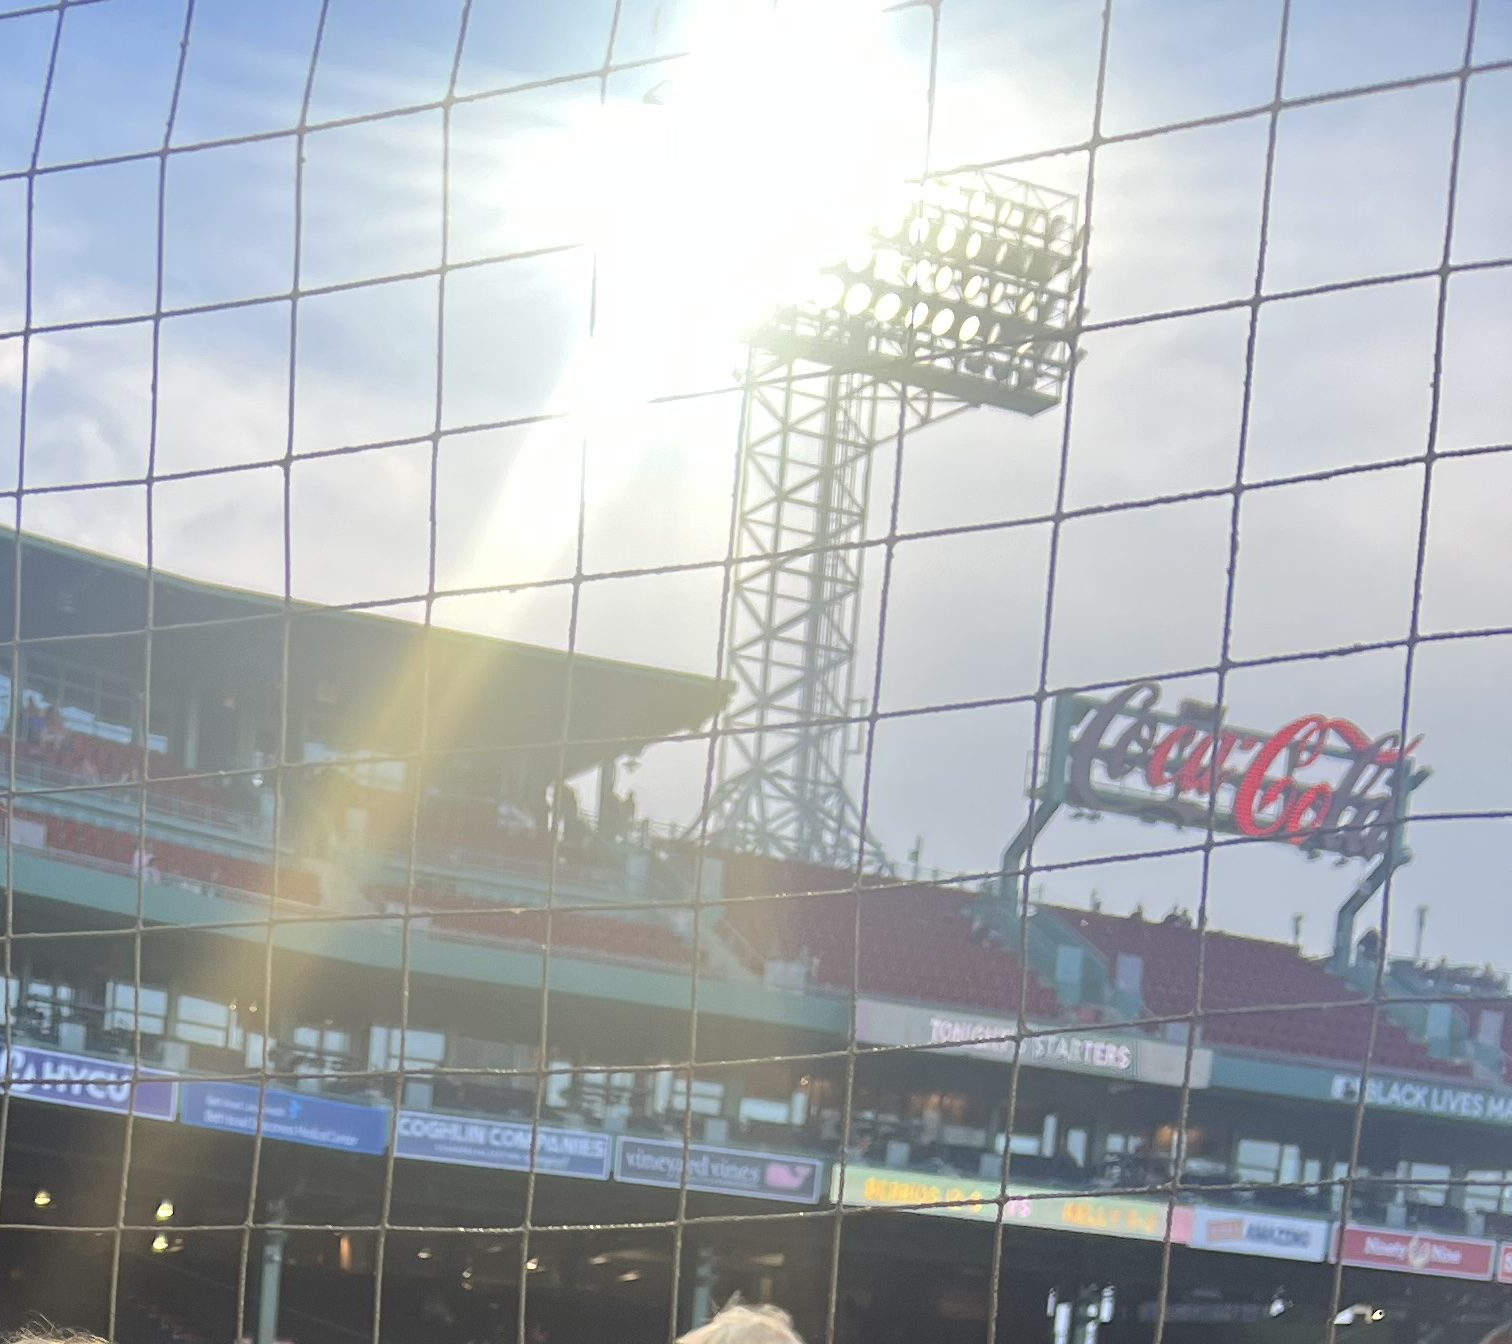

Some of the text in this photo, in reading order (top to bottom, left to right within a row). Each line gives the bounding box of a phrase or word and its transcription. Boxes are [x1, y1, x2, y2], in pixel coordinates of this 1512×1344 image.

[930, 1017, 1131, 1070] TONIGHTS STARTERS
[42, 1062, 132, 1102] HYCU
[1368, 1078, 1430, 1108] BLACK
[1431, 1087, 1485, 1119] LIVES
[398, 1117, 485, 1146] COGHLIN
[488, 1126, 606, 1158] COMPANIES
[711, 1159, 761, 1184] vines
